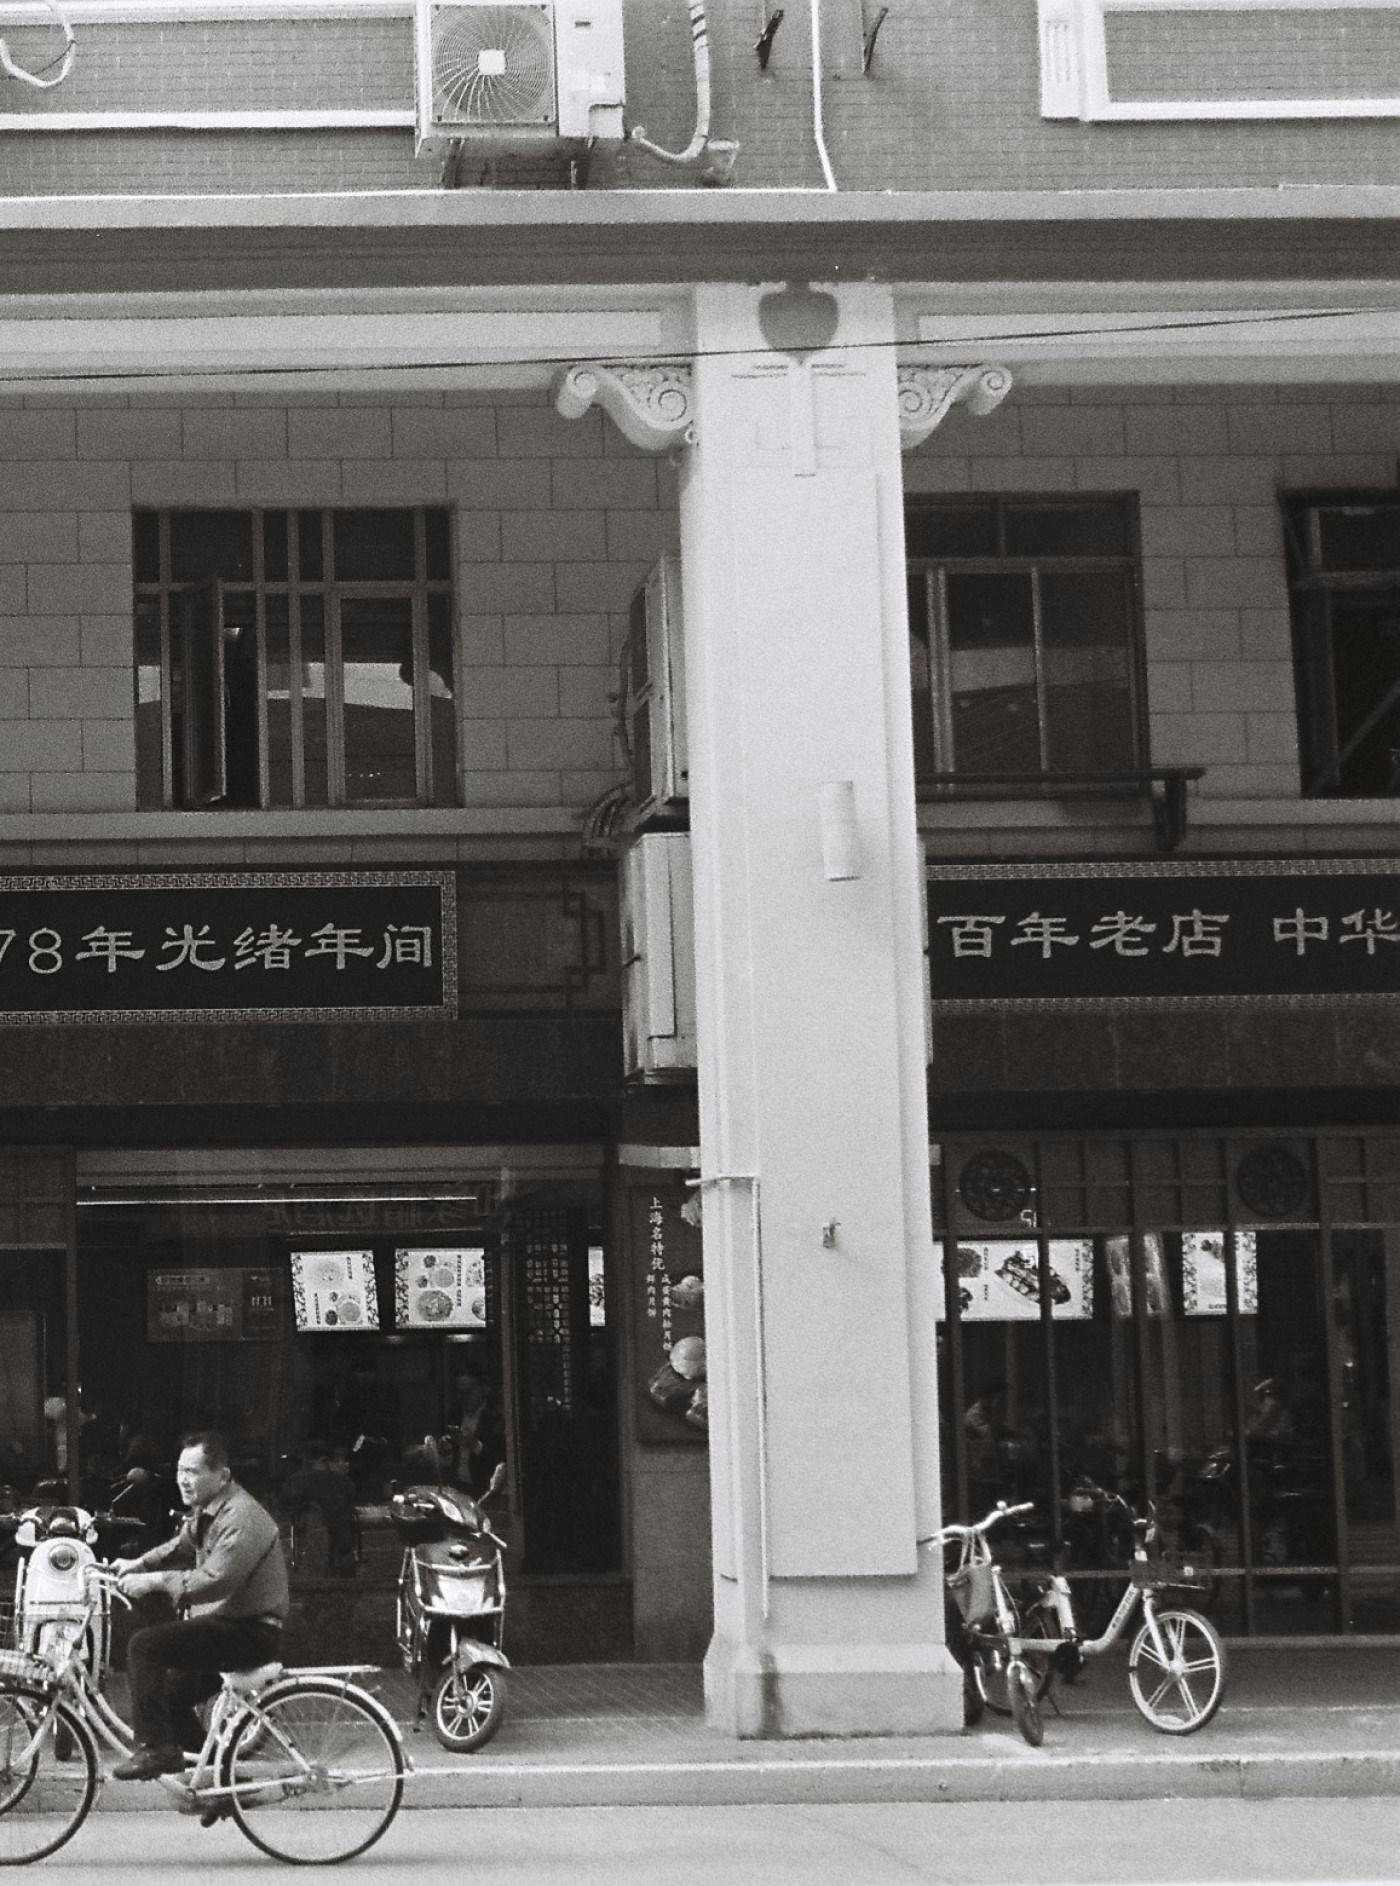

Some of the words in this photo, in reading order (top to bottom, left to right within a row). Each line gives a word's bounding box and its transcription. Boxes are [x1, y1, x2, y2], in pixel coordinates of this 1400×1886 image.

[937, 908, 1231, 960] 百年老店
[1273, 906, 1400, 957] 中华
